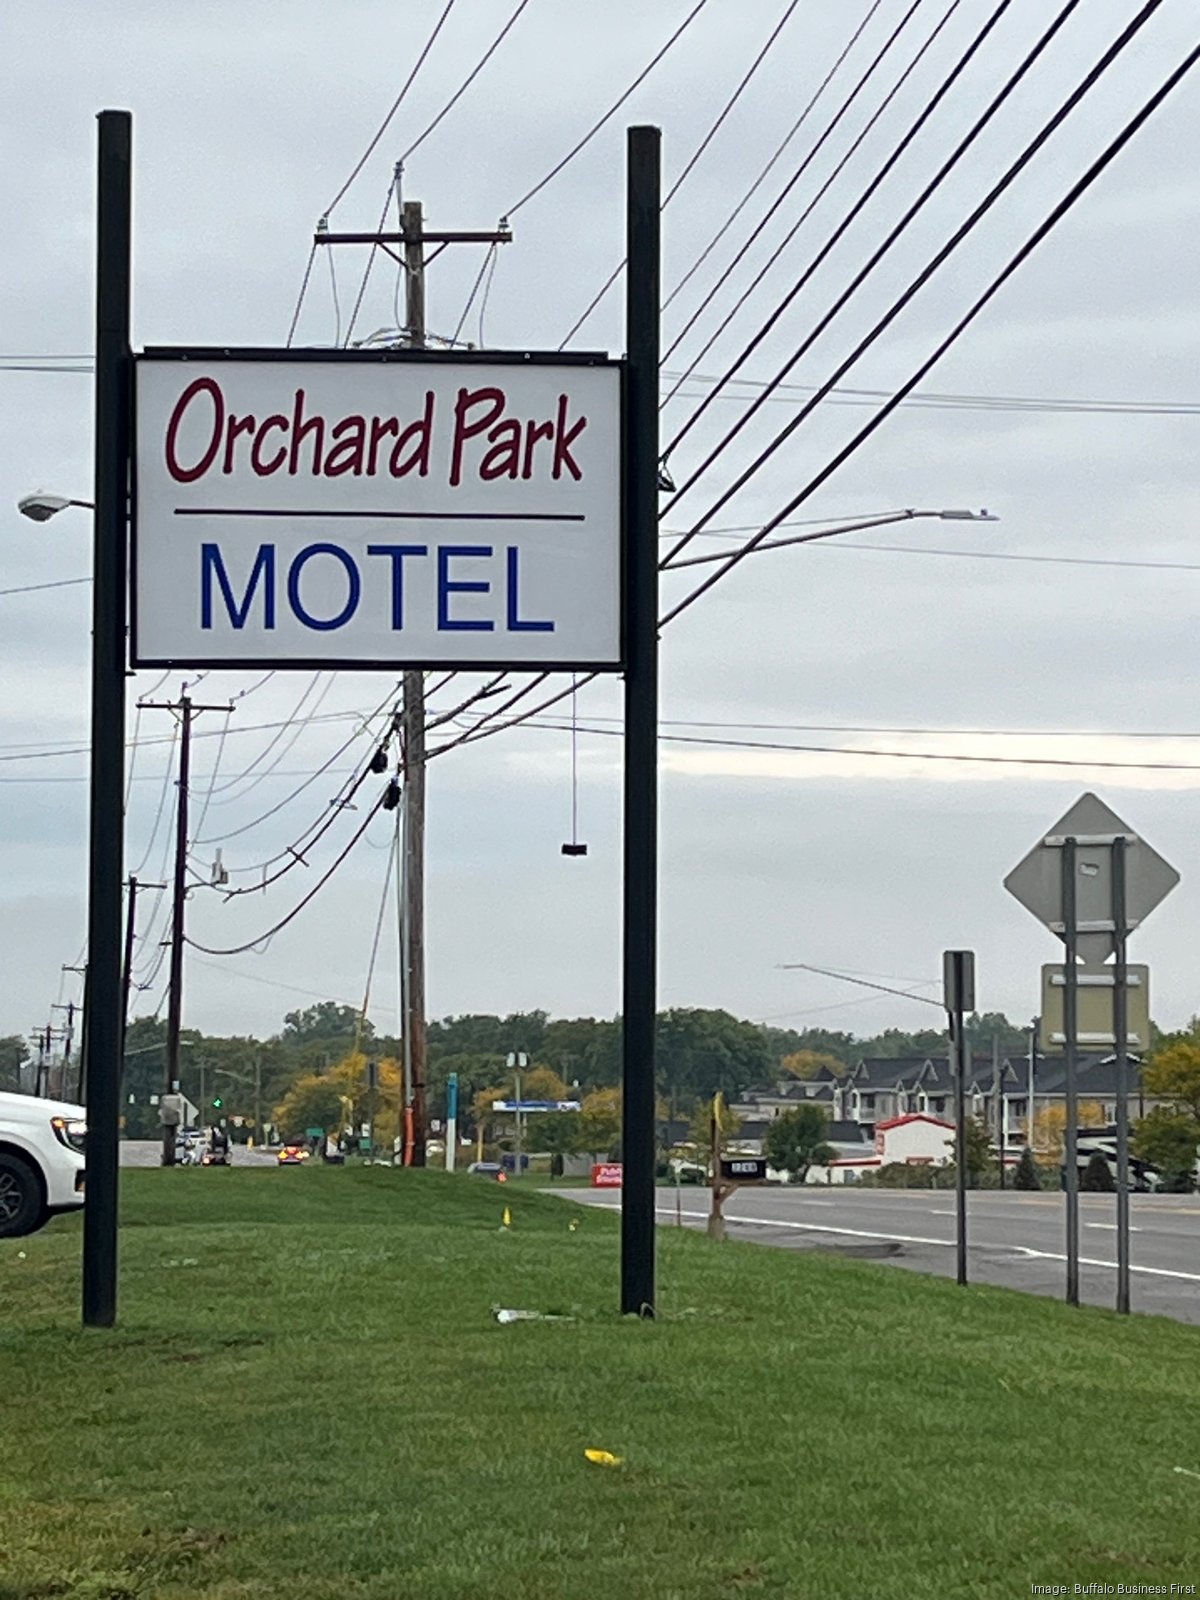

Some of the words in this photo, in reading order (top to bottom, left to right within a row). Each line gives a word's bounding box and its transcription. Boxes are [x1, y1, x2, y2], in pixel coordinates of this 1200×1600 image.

[166, 377, 435, 483] Orchard
[450, 387, 587, 486] Park
[201, 543, 555, 632] MOTEL
